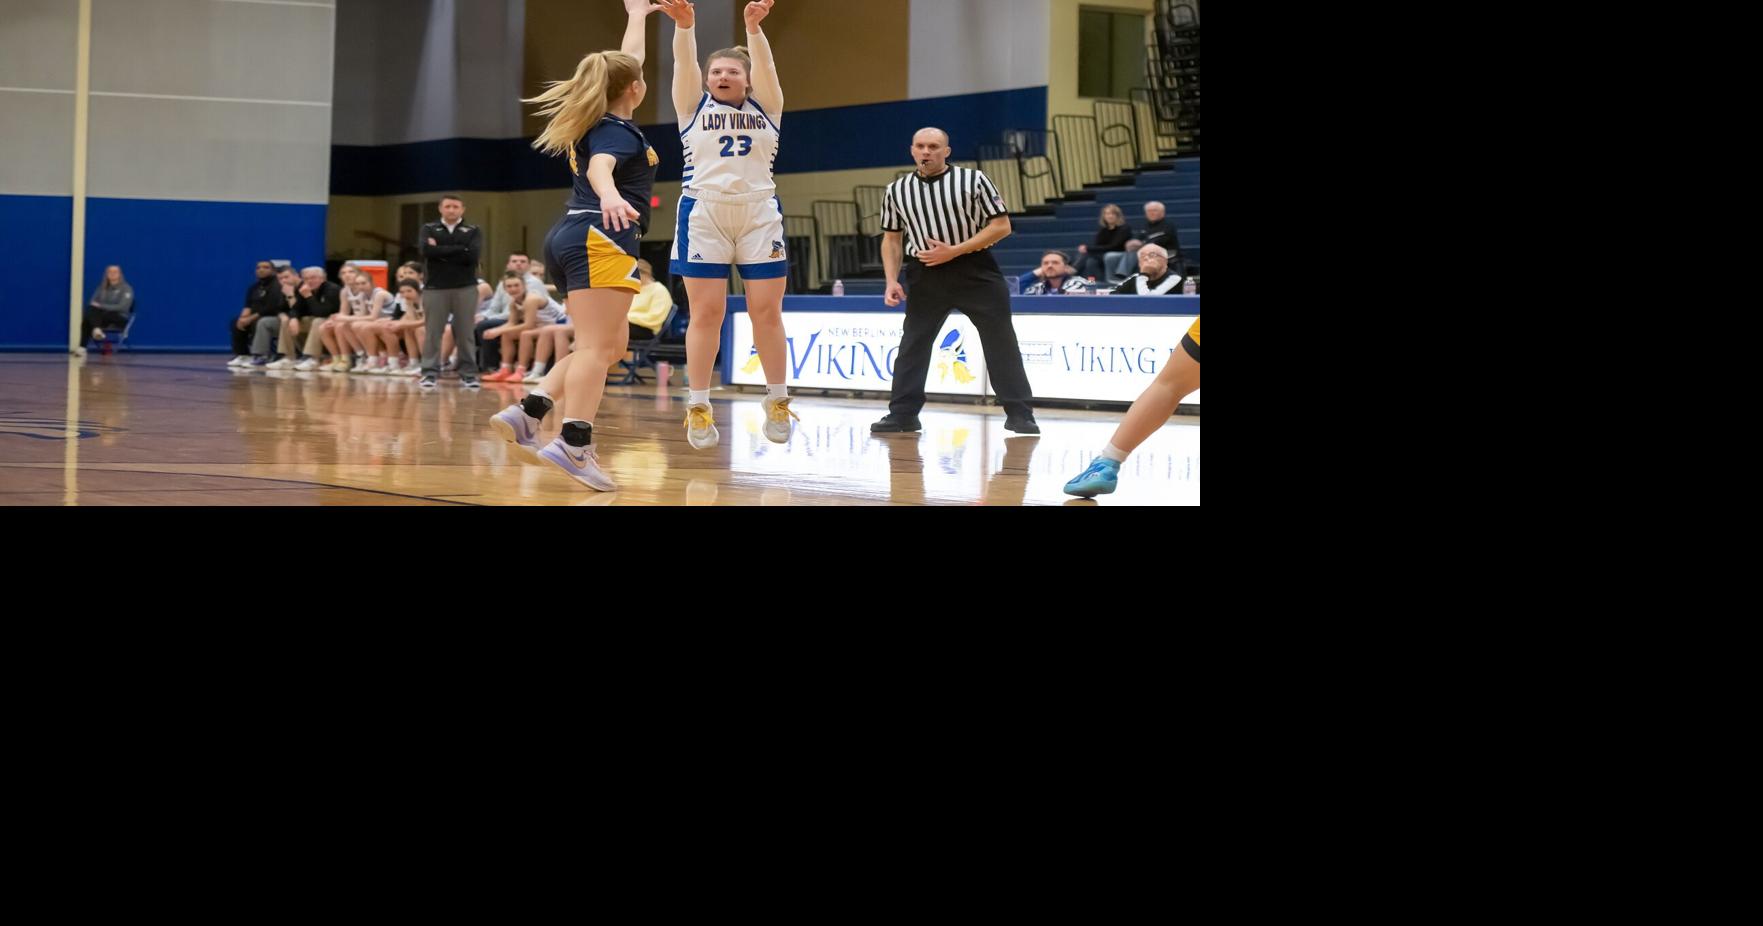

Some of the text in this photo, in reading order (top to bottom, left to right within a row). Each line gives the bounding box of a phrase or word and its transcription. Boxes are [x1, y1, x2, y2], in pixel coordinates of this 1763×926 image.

[702, 112, 767, 131] LADY VIKINGS
[718, 134, 753, 158] 23
[828, 327, 849, 337] NEW
[852, 327, 885, 338] BERLIN
[1061, 342, 1156, 375] VIKING
